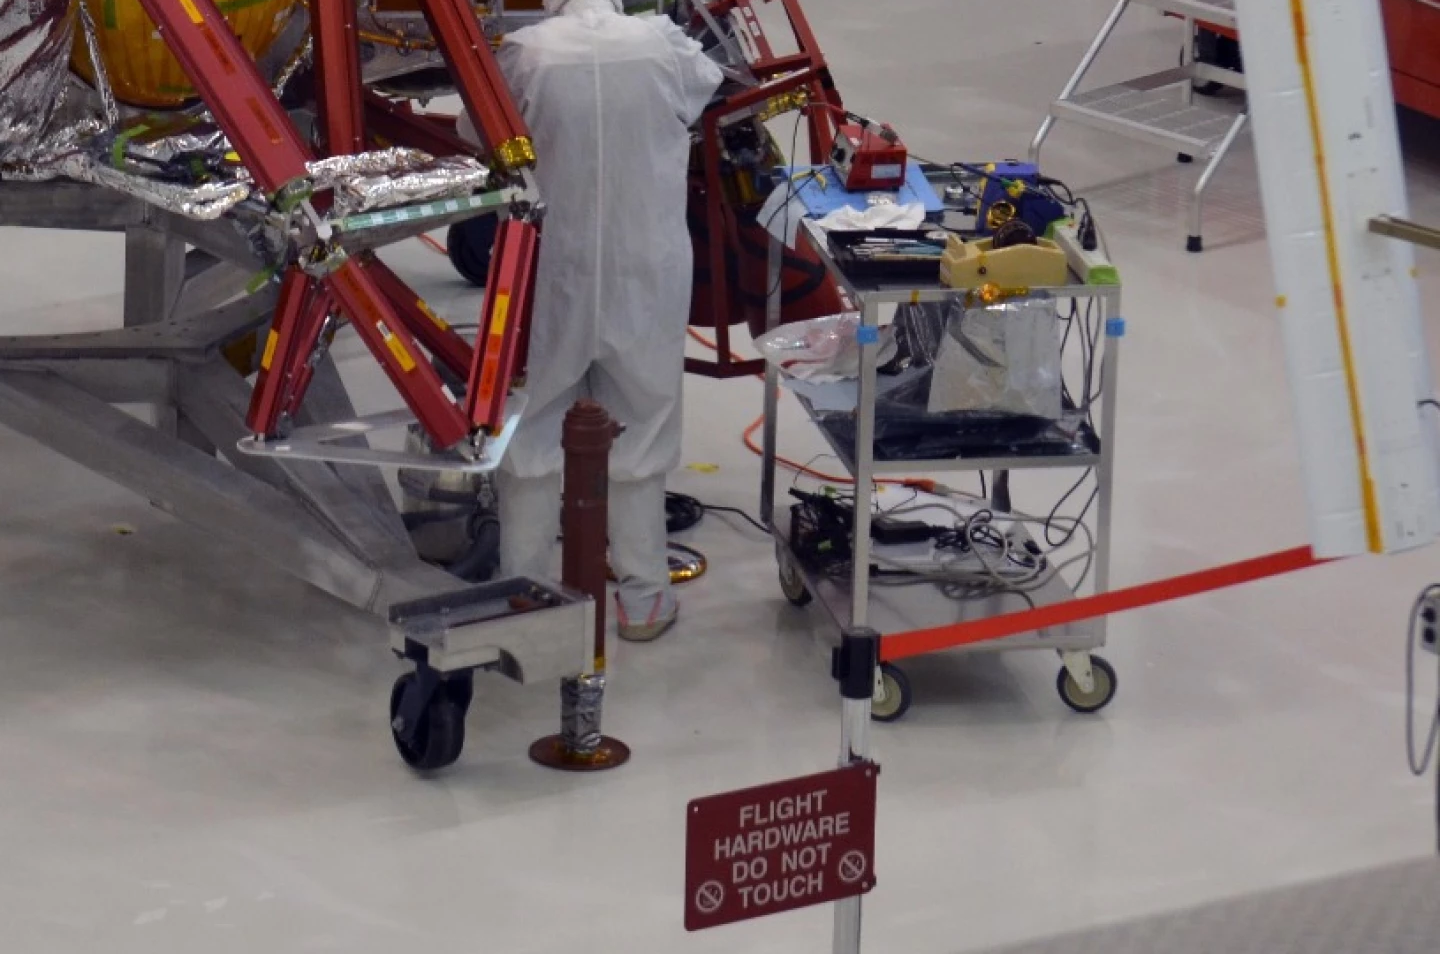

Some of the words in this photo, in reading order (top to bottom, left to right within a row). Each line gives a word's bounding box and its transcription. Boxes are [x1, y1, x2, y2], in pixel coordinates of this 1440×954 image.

[739, 789, 828, 828] FLIGHT
[714, 812, 851, 861] HARDWARE
[732, 857, 768, 884] DO
[781, 843, 832, 874] NOT
[738, 871, 823, 909] TOUCH
